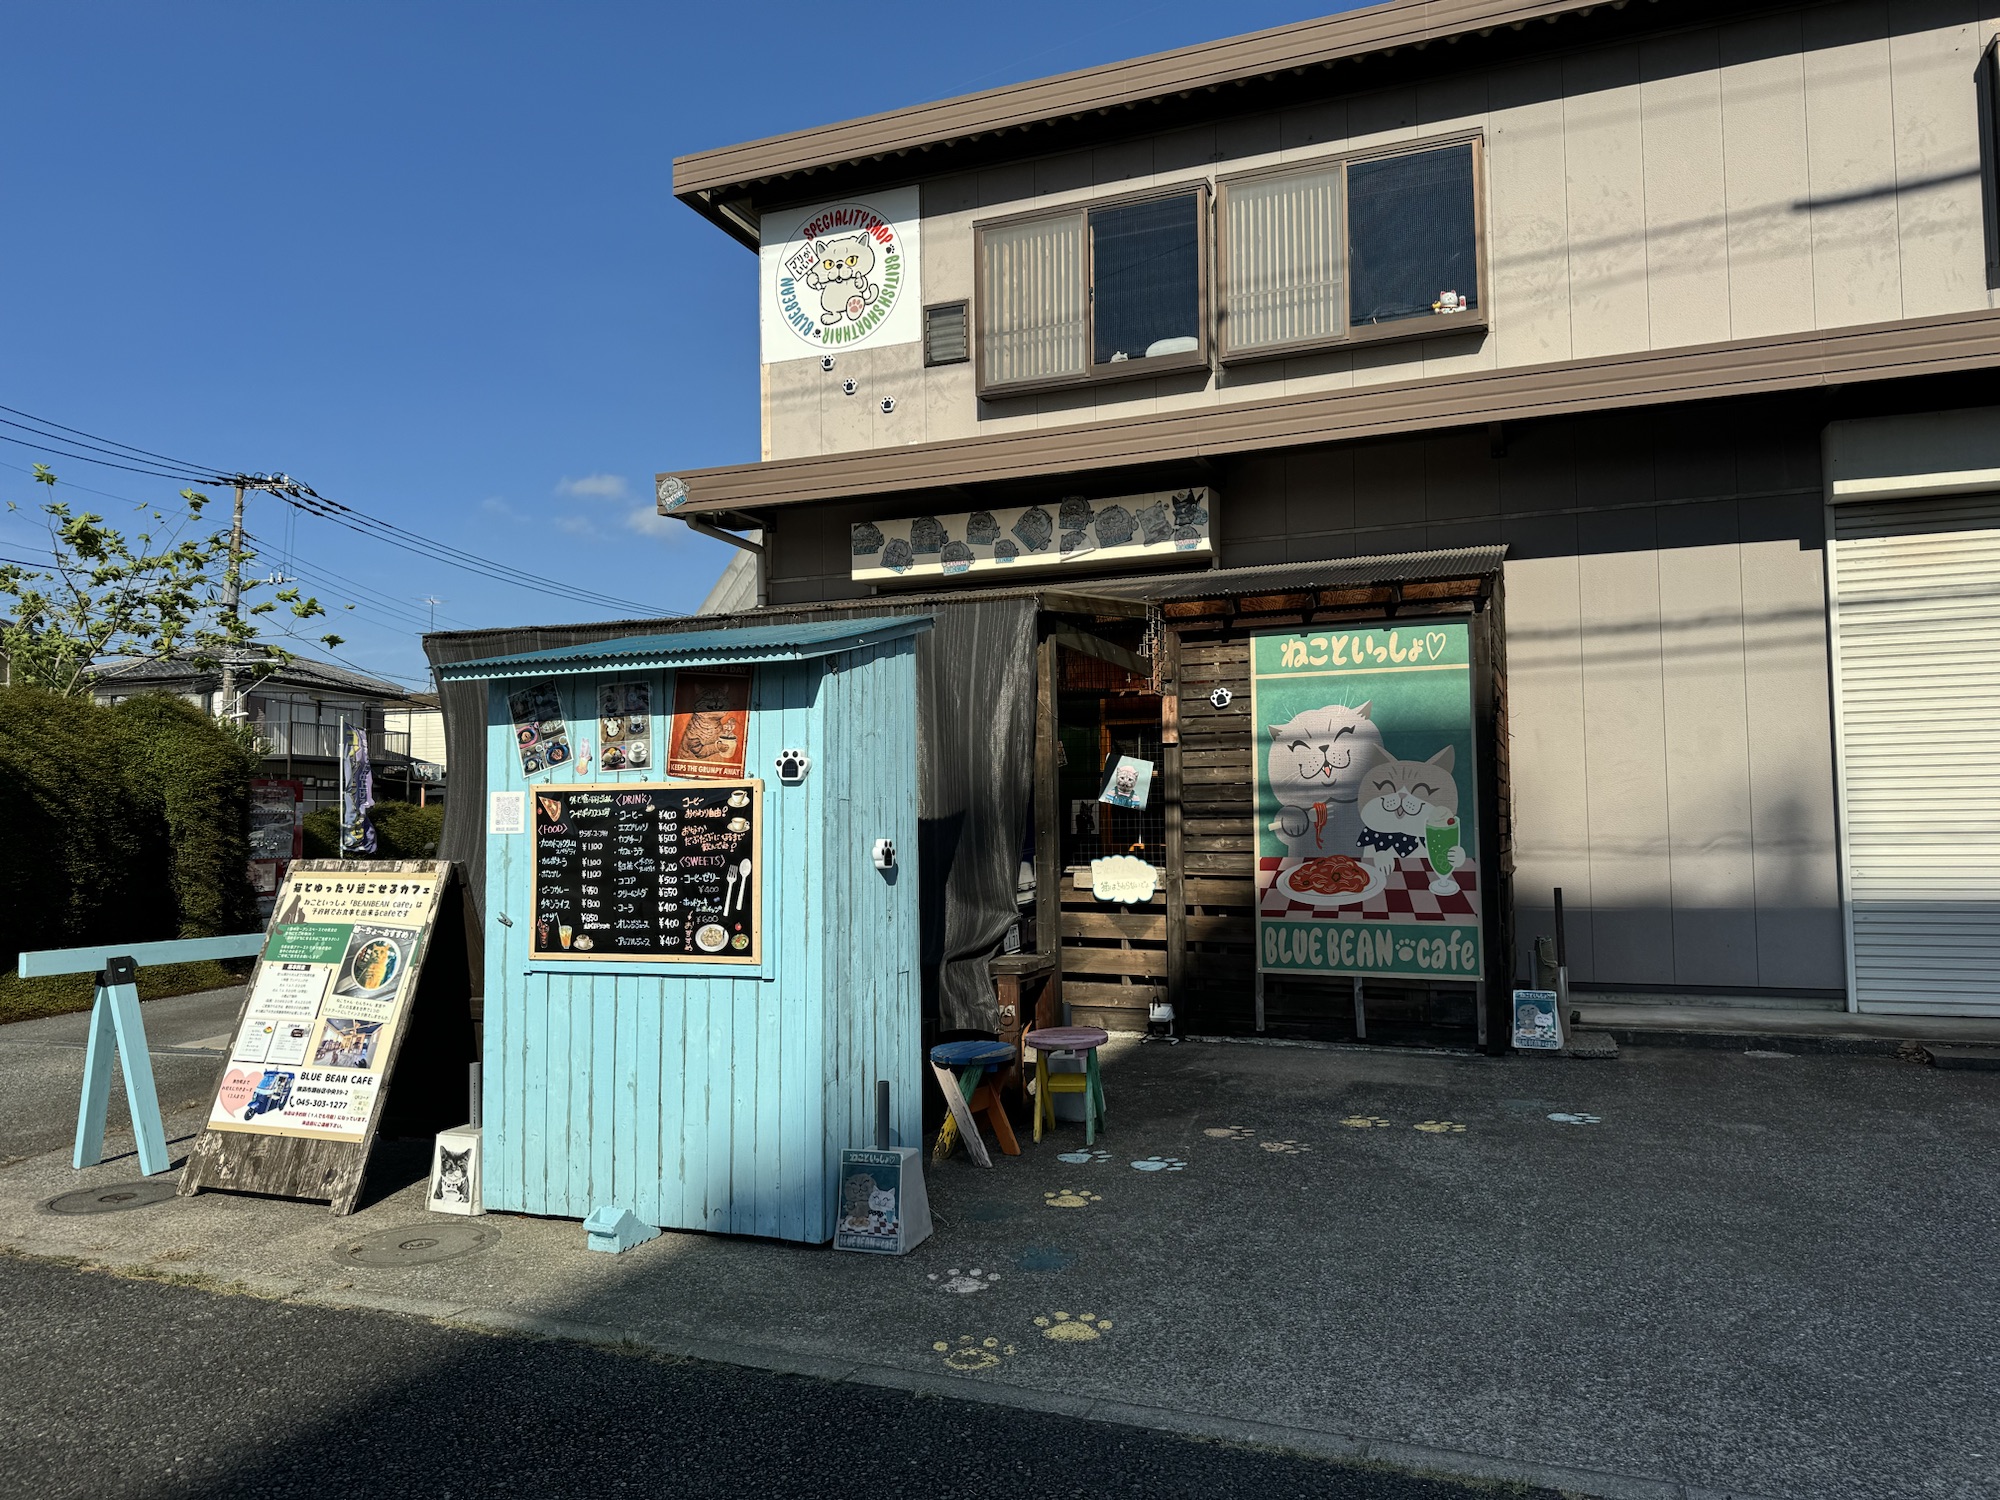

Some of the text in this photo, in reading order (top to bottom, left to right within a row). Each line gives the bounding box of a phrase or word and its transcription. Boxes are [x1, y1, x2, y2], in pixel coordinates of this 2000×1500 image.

[1280, 631, 1424, 668] ねこといっしょ
[671, 764, 741, 776] KEEPS THE GRUMPY AWAY
[619, 810, 643, 821] コーヒー
[618, 876, 636, 885] ココア
[293, 882, 431, 895] 猫とゆったり過ごせるカフェ
[617, 901, 678, 913] コーラ ¥400
[658, 917, 679, 929] ¥400
[1264, 925, 1477, 973] BLUE BEAN cafe
[300, 1071, 373, 1085] BLUE BEAN CAFE
[296, 1098, 348, 1109] 045-303-1277
